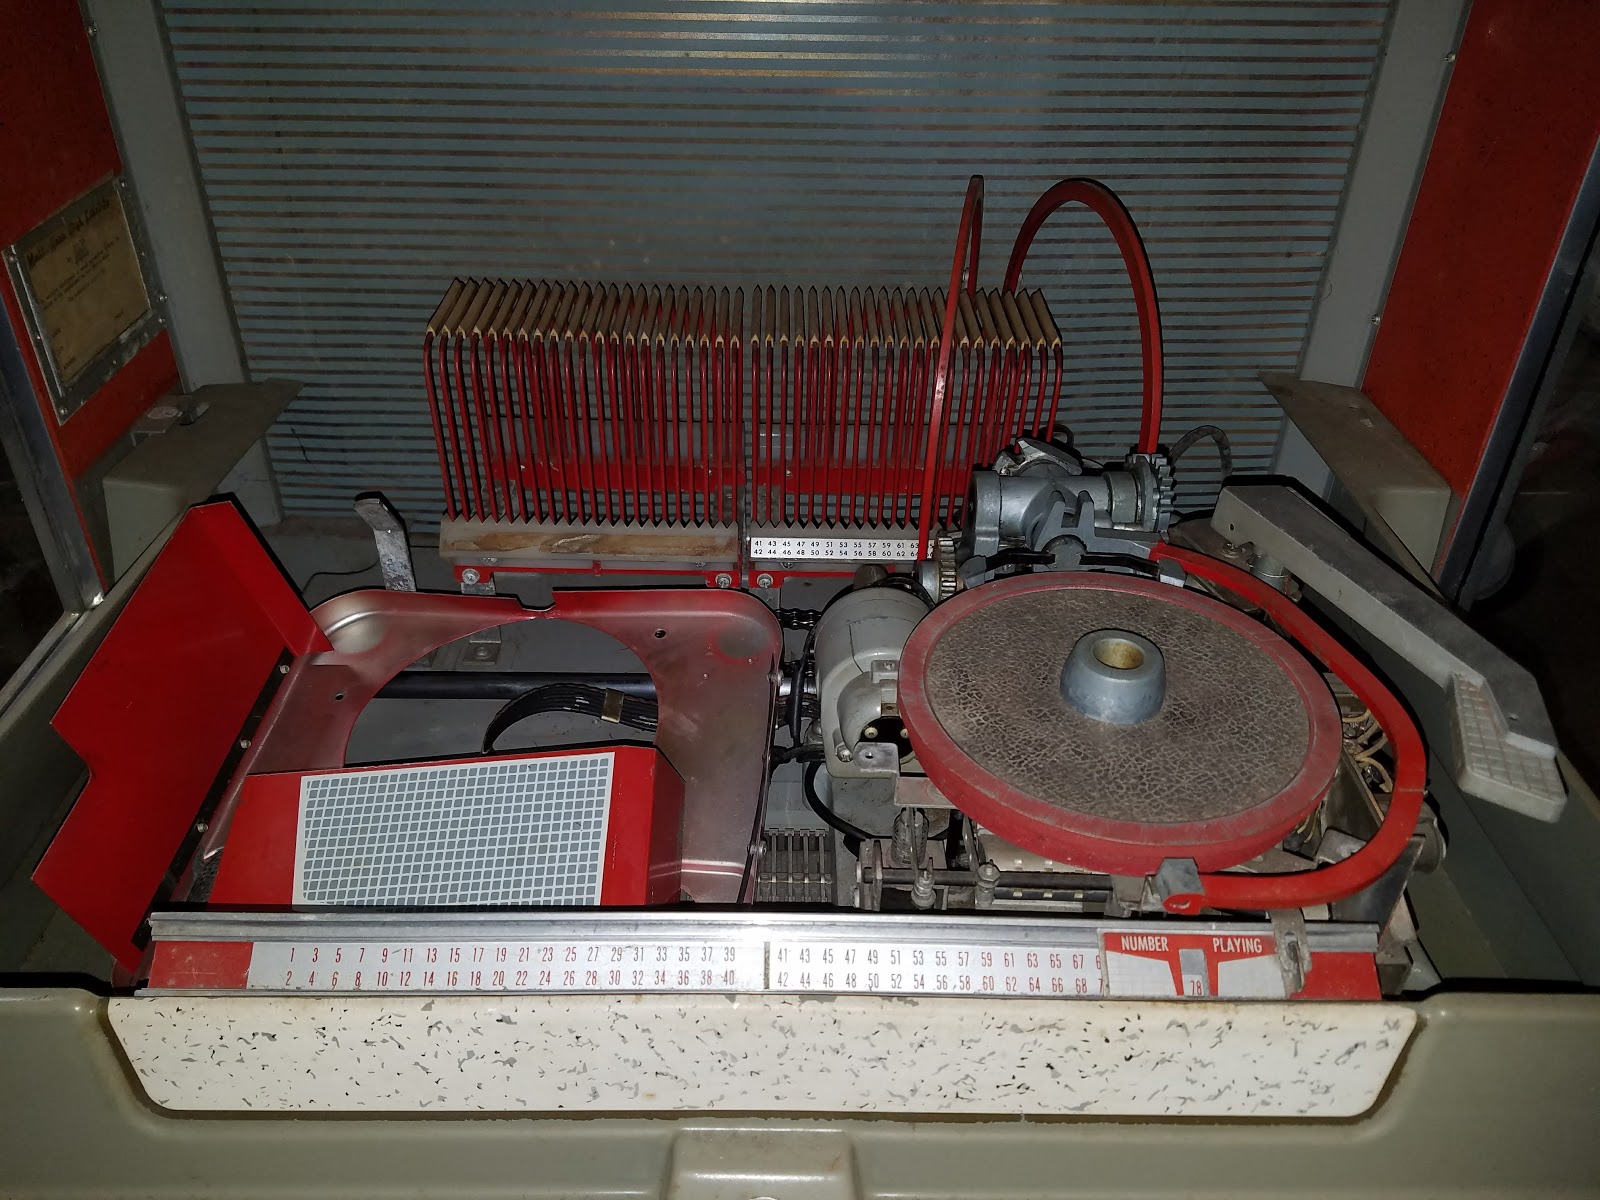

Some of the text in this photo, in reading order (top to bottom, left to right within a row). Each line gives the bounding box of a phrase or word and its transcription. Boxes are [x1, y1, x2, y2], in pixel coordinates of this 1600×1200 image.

[1121, 936, 1262, 953] NUMBER PLAYING
[312, 947, 318, 962] 3
[335, 948, 342, 963] 5
[359, 948, 365, 962] 7
[382, 948, 388, 963] 9
[404, 948, 413, 963] 11
[427, 948, 437, 963] 13
[450, 948, 460, 963] 15
[473, 948, 484, 962] 17
[497, 947, 506, 962] 19
[519, 947, 529, 962] 21
[542, 947, 553, 962] 23
[565, 947, 577, 962] 25
[588, 947, 599, 961] 27
[611, 947, 622, 962] 29
[634, 947, 644, 962] 31
[656, 946, 667, 961] 33
[679, 947, 690, 961] 35
[701, 947, 712, 961] 37
[724, 947, 735, 961] 39
[778, 948, 787, 961] 41
[800, 948, 810, 963] 43
[823, 948, 833, 963] 45
[845, 949, 855, 964] 47
[868, 950, 878, 964] 49
[891, 950, 900, 965] 51
[913, 950, 924, 965] 53
[936, 951, 947, 966] 55
[958, 952, 969, 966] 57
[981, 952, 992, 967] 59
[1004, 953, 1014, 967] 61
[1027, 953, 1038, 968] 63
[1050, 954, 1061, 968] 65
[1073, 954, 1083, 969] 67
[286, 970, 734, 986] 2 4 6 8 10 12 14 16 18 20 22 24 26 28 30 32 34 36 38 40
[778, 972, 788, 987] 42
[800, 973, 810, 988] 44
[823, 973, 833, 987] 46
[846, 973, 856, 988] 48
[869, 973, 879, 988] 50
[891, 974, 902, 989] 52
[914, 974, 924, 989] 54
[937, 975, 947, 990] 56
[959, 975, 970, 990] 58
[982, 976, 994, 991] 60
[1006, 976, 1017, 991] 62
[1029, 977, 1040, 992] 64
[1052, 978, 1063, 992] 66
[1076, 978, 1087, 993] 68
[1190, 980, 1202, 996] 78
